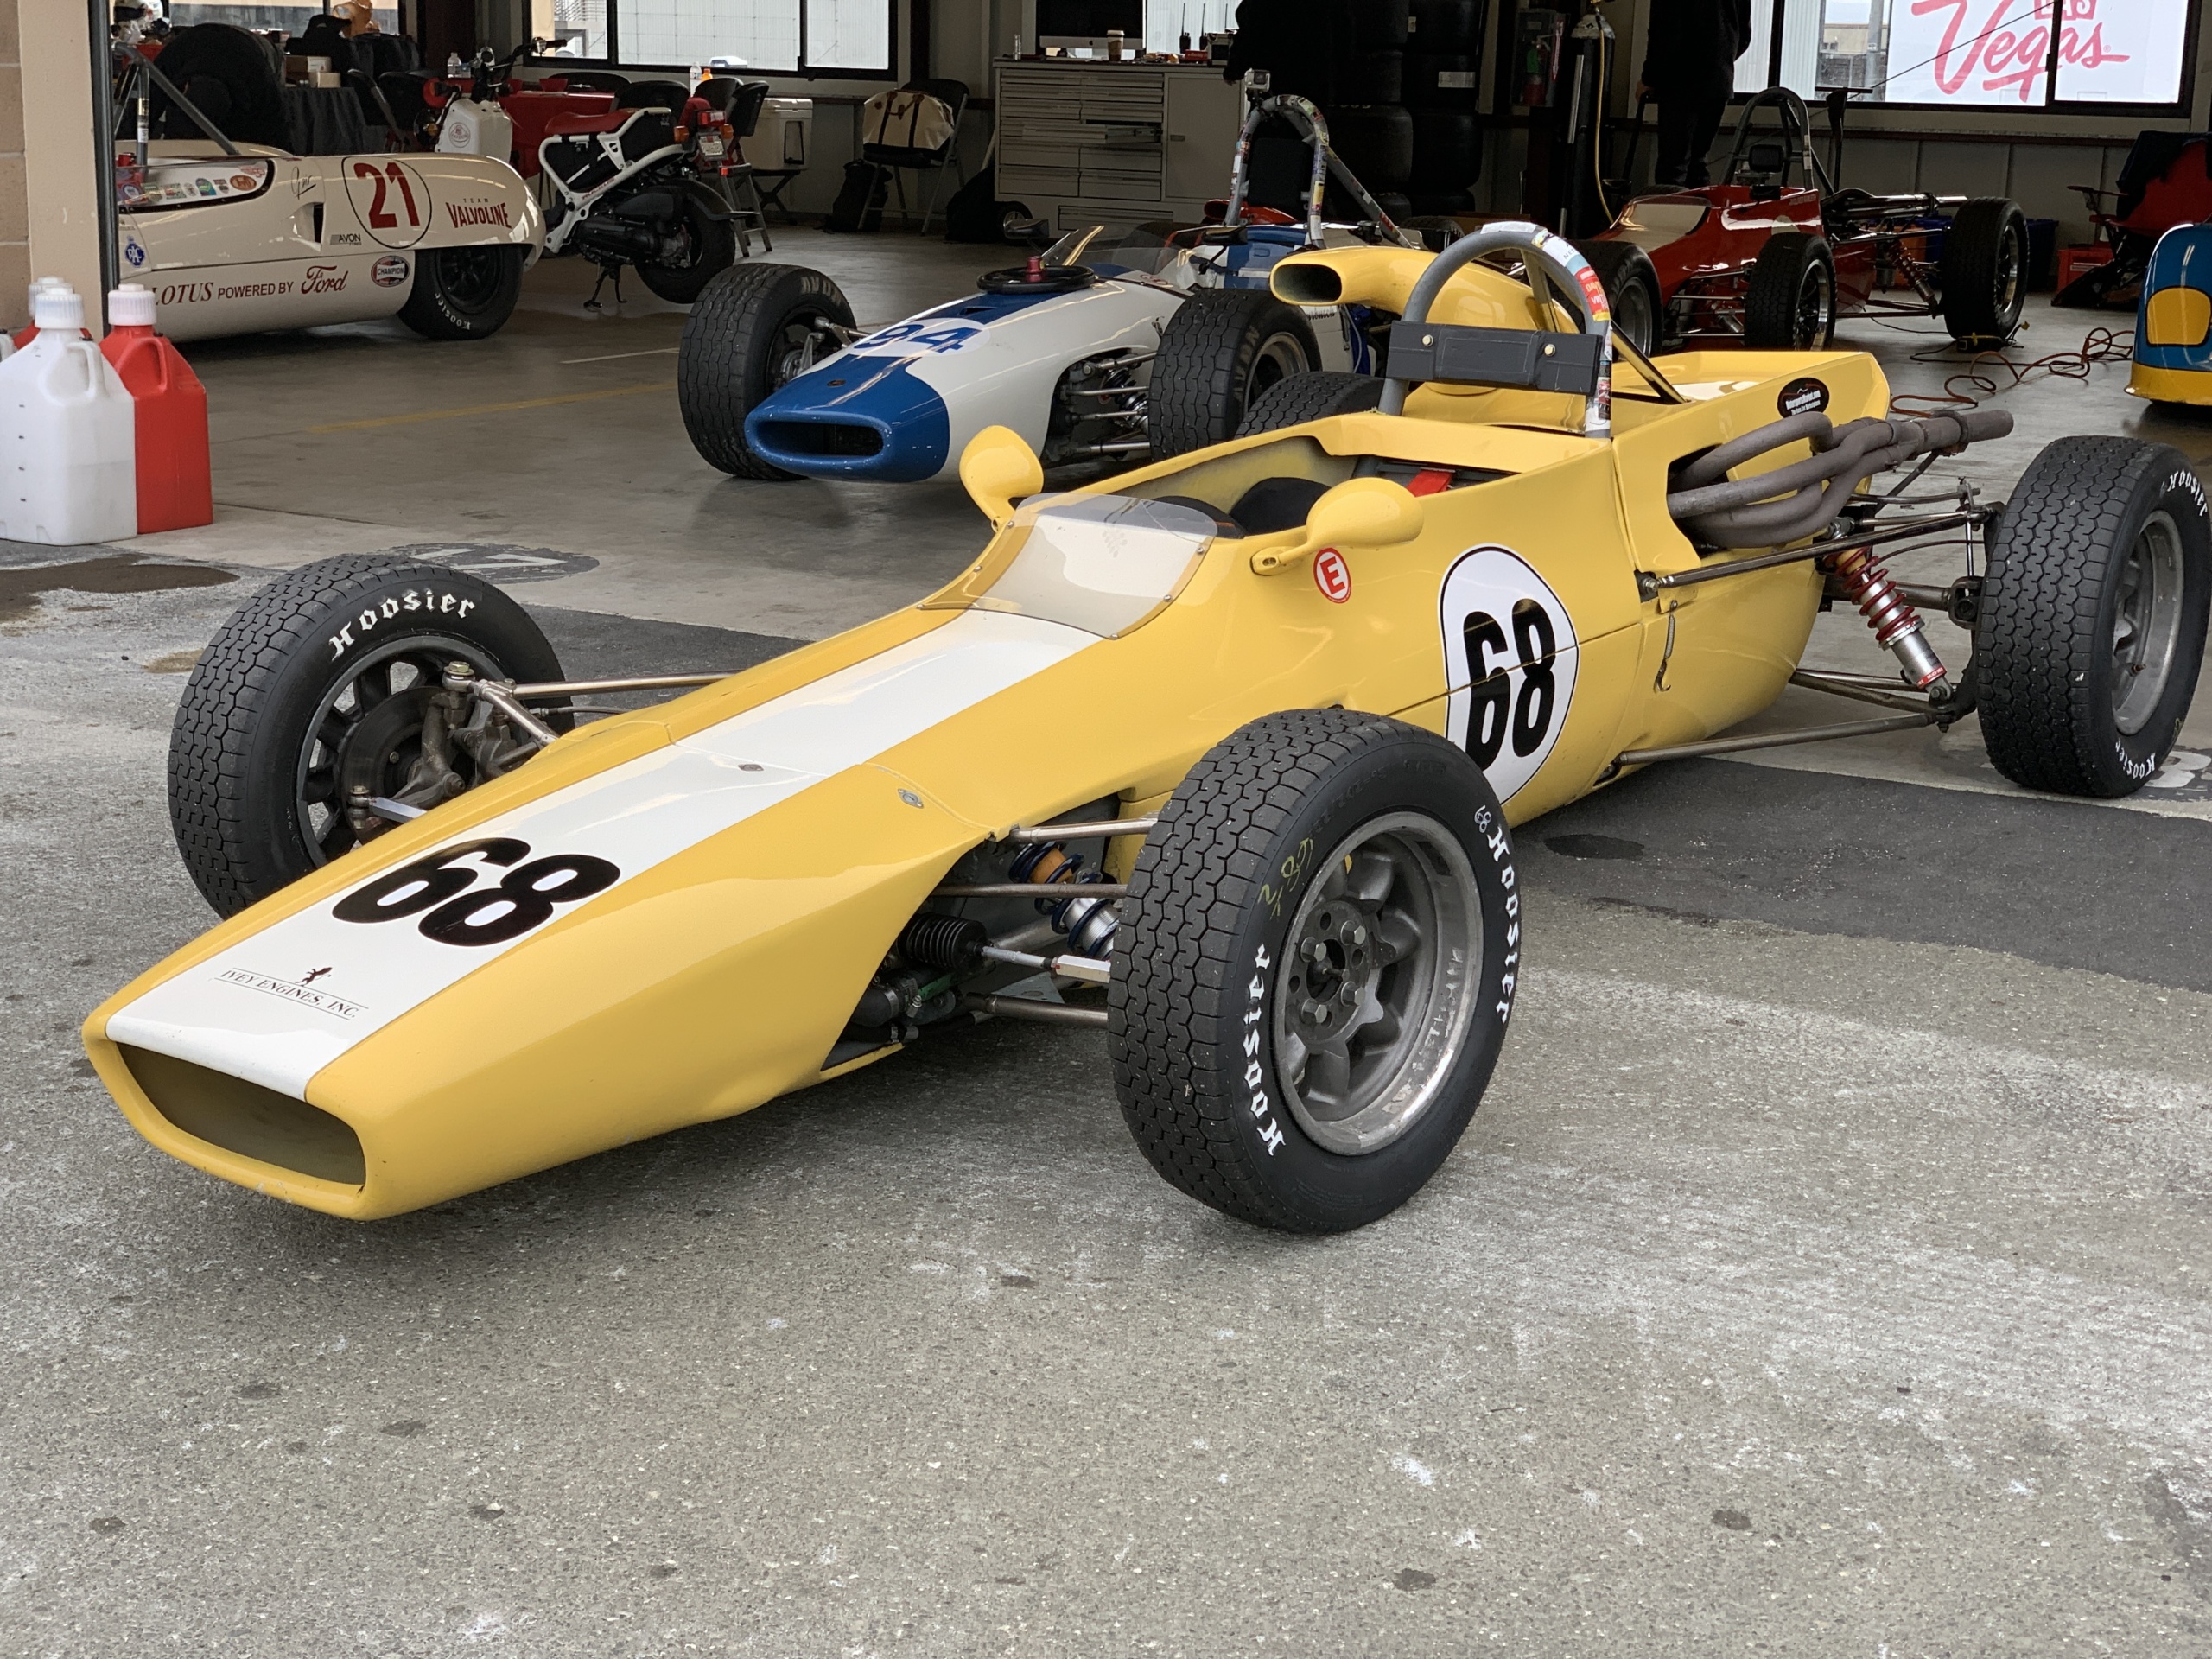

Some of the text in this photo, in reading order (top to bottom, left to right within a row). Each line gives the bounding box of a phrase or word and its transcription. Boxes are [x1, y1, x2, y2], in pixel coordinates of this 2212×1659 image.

[1910, 0, 2130, 103] Vegas
[353, 161, 421, 230] 21
[445, 201, 512, 230] VALVOLINE
[338, 232, 361, 243] AVON
[377, 267, 404, 276] CHAMPION
[217, 283, 276, 300] POWERED
[277, 281, 295, 295] BY
[300, 265, 349, 295] Ford
[1319, 556, 1346, 595] E
[327, 588, 476, 663] Hoosier
[1463, 598, 1556, 772] 68
[331, 836, 621, 948] 68
[1485, 823, 1521, 1025] Hoosier
[219, 969, 359, 1018] IVEY ENGINES, INC.
[1242, 943, 1287, 1156] Hoosier
